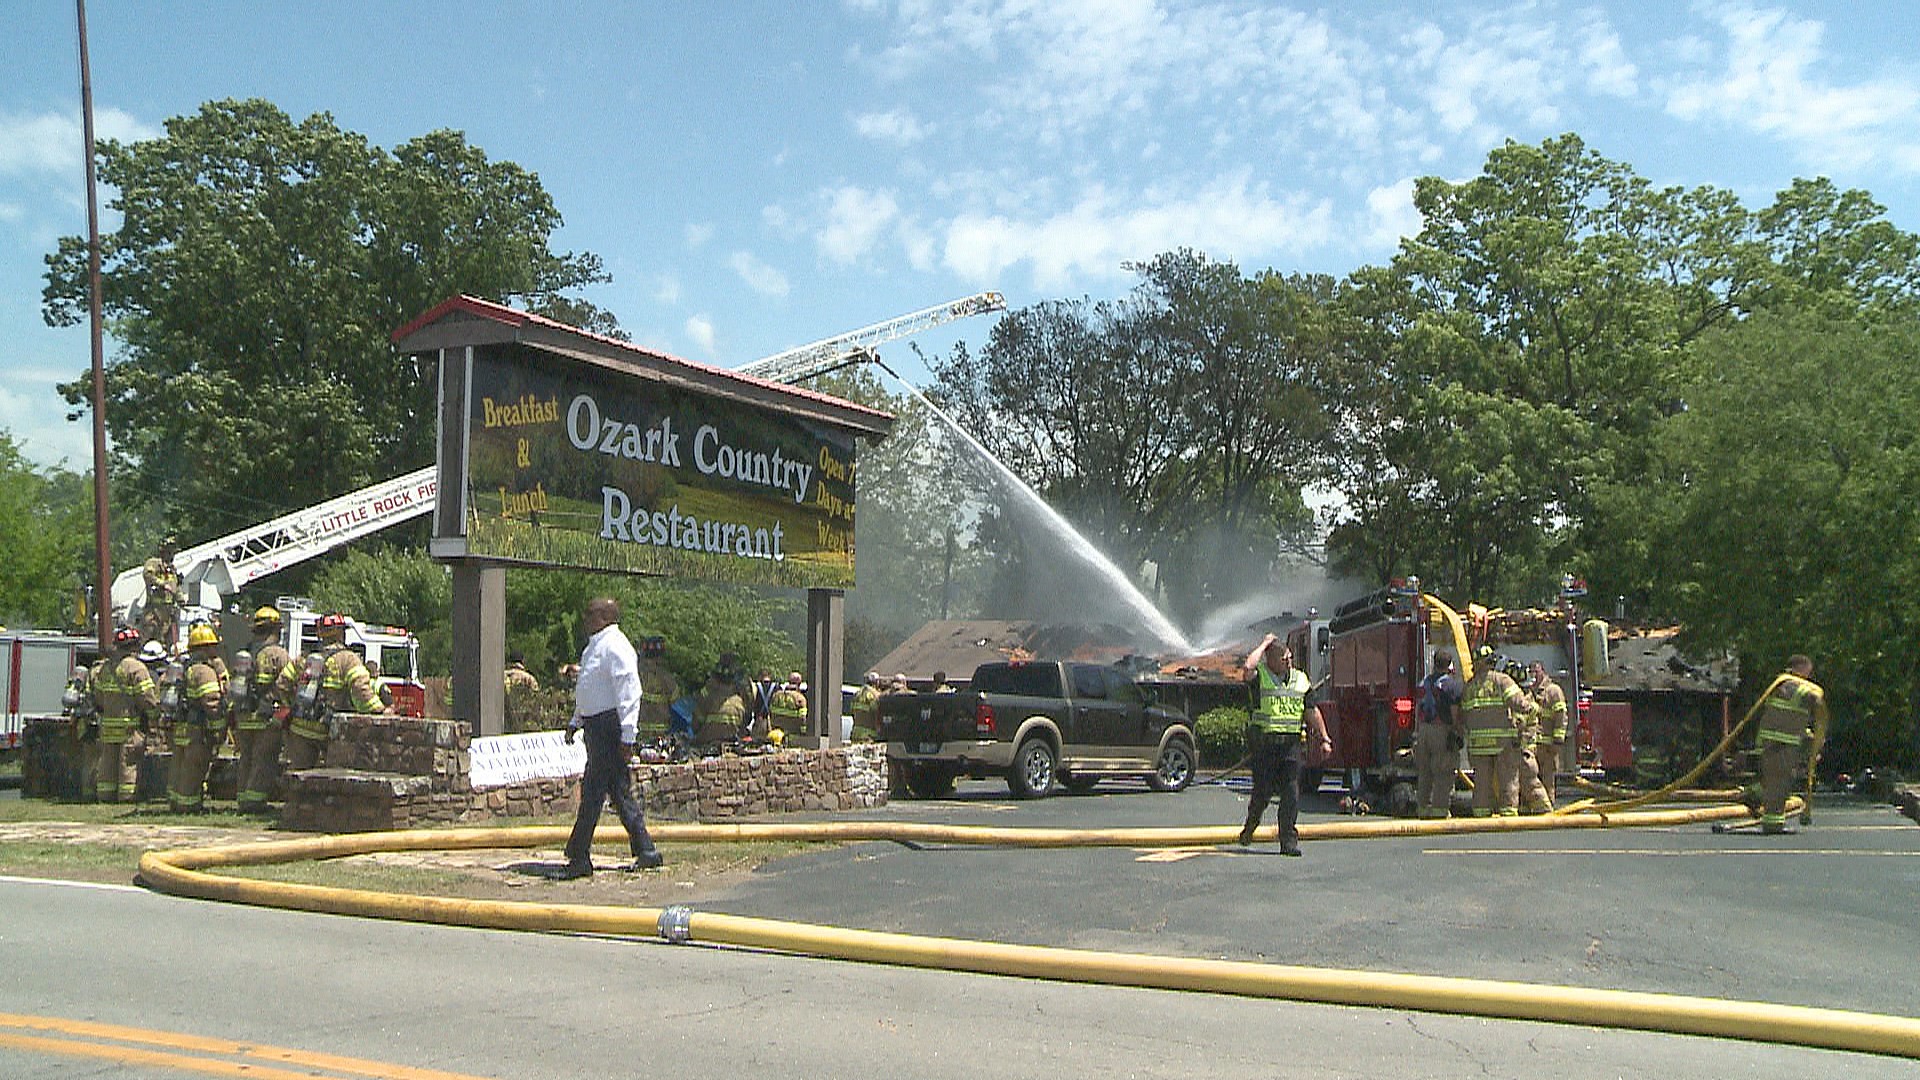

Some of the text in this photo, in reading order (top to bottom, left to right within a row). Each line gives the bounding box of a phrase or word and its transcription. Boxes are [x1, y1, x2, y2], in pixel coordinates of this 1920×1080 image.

[483, 393, 559, 429] Breakfast
[517, 438, 531, 469] &
[567, 395, 813, 504] Ozark Country
[819, 446, 844, 481] Open
[322, 506, 369, 533] LITTLE
[374, 490, 413, 515] ROCK
[499, 482, 548, 515] Lunch
[816, 480, 842, 518] Days
[600, 486, 785, 562] Restaurant
